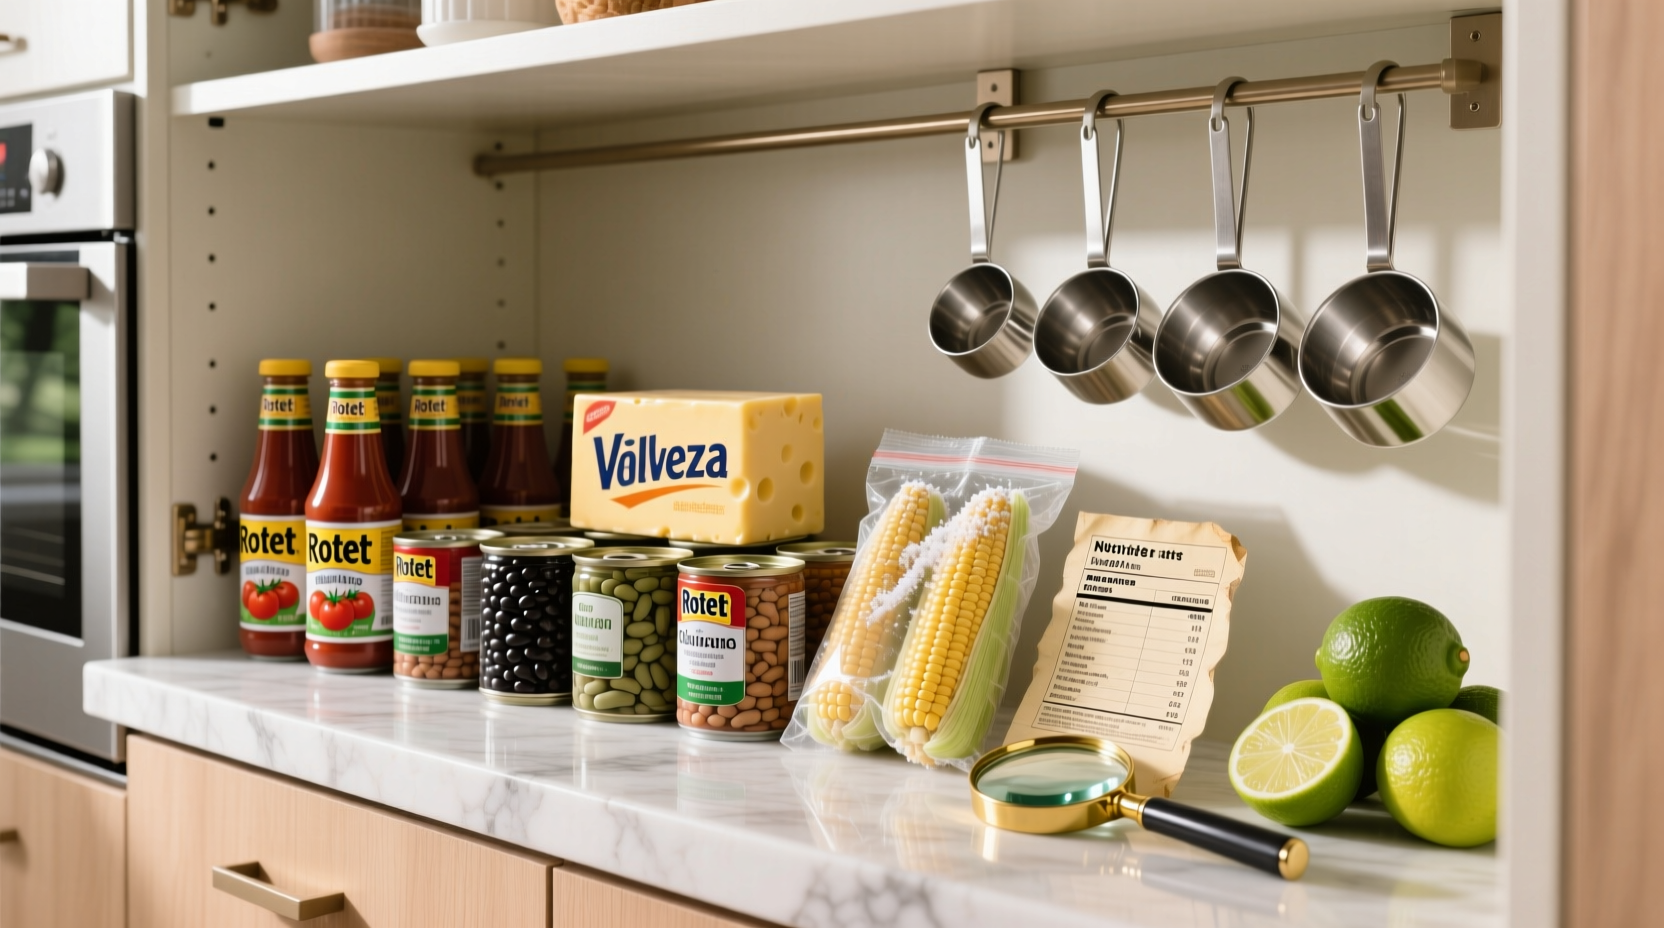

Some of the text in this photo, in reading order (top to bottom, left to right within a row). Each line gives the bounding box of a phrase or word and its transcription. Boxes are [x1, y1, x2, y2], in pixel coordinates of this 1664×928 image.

[240, 525, 297, 556] Rotet
[308, 532, 373, 565] Rotet
[682, 589, 729, 618] Rotet
